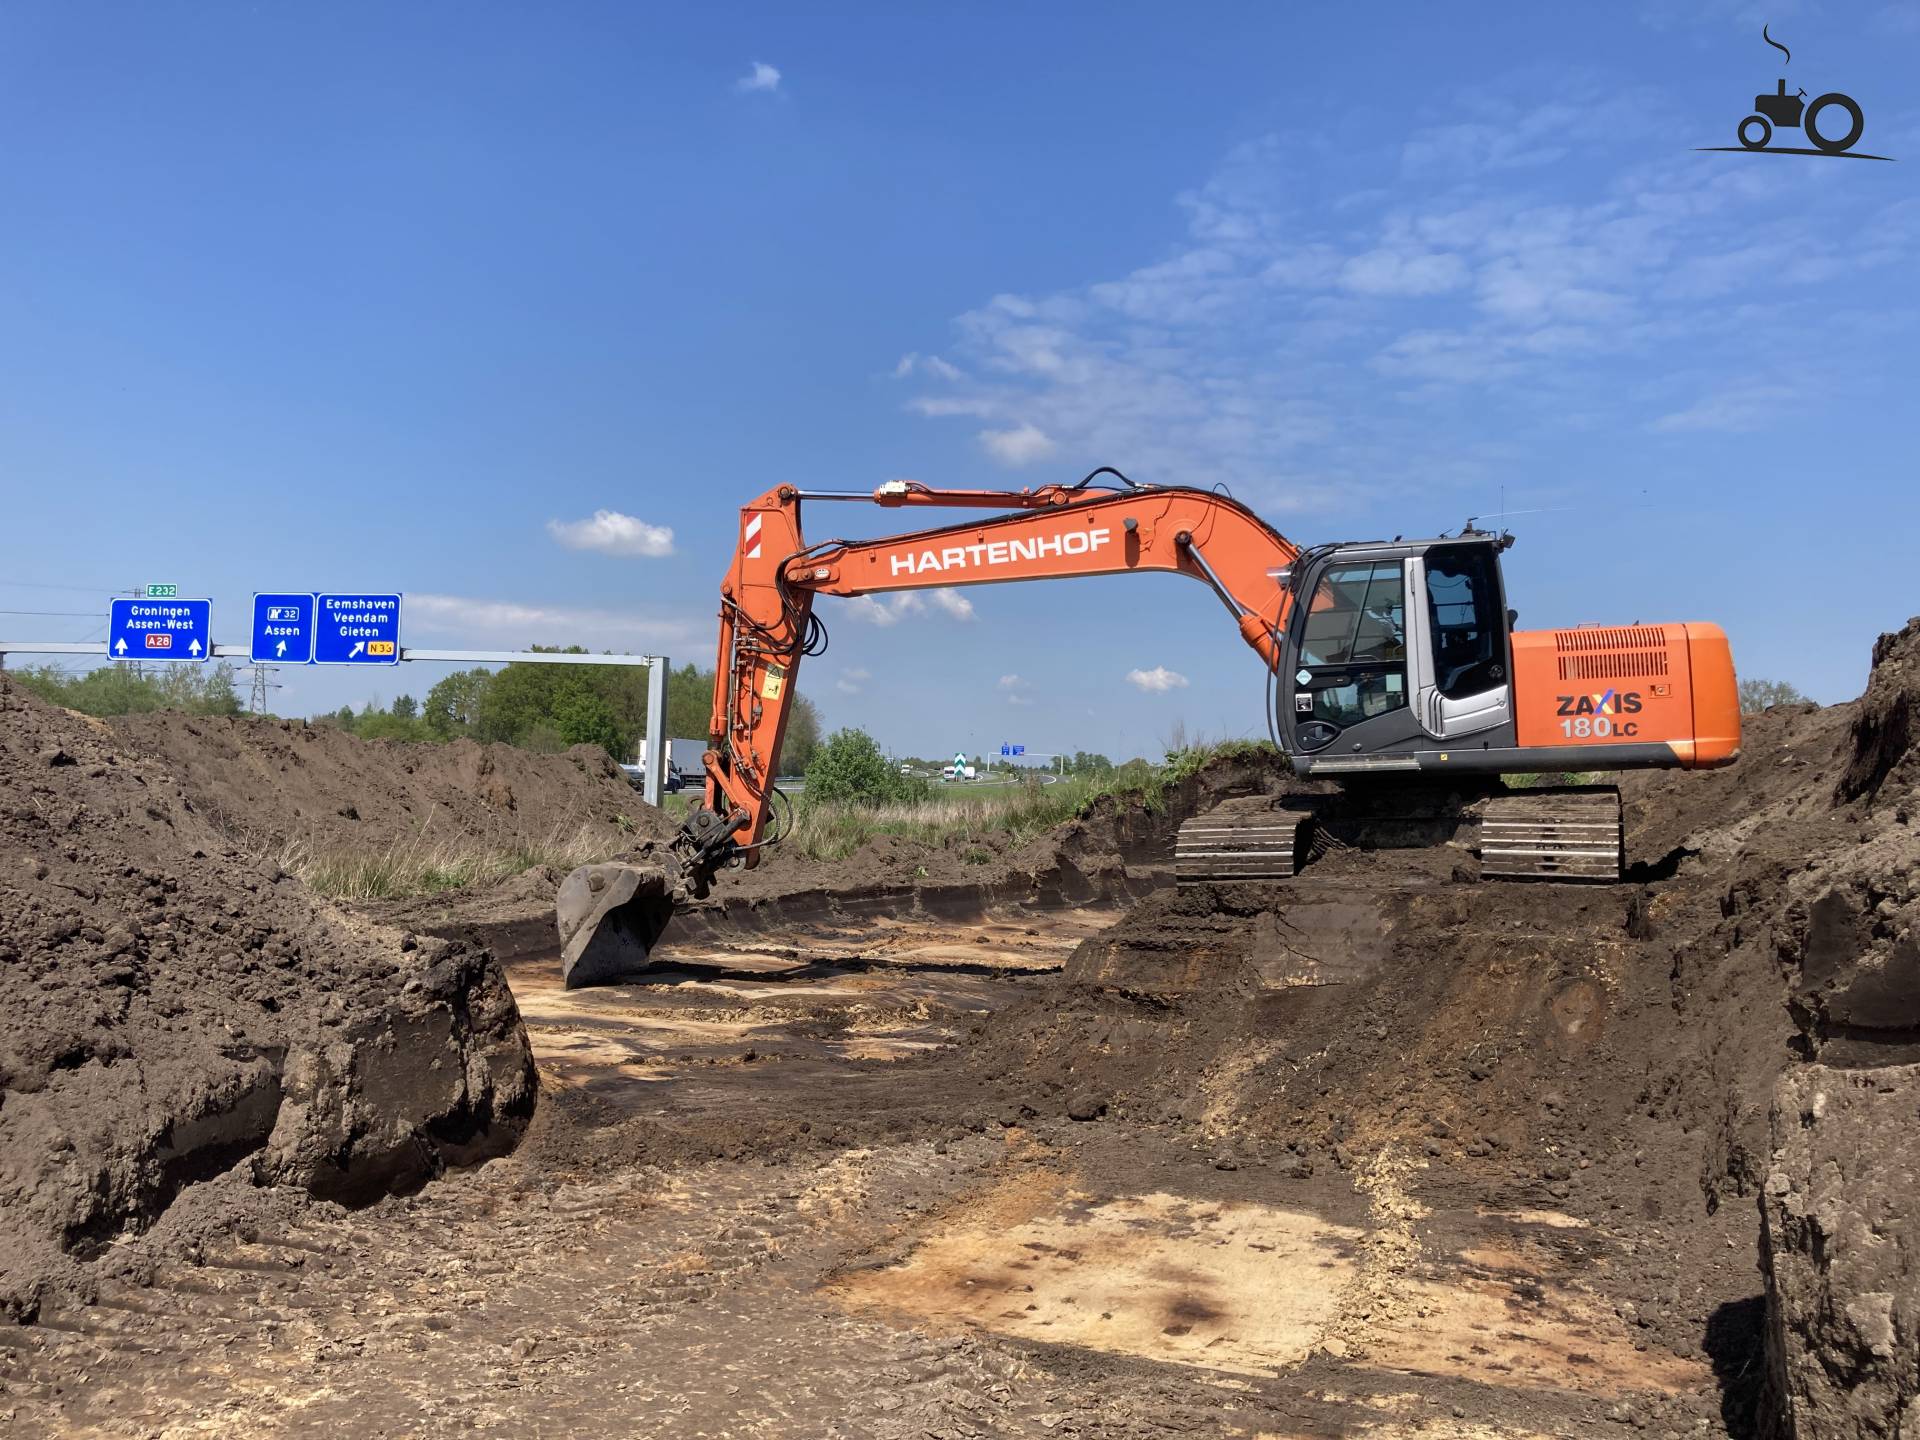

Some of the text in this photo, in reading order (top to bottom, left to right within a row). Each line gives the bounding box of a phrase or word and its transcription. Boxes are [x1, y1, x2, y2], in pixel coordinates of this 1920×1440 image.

[891, 529, 1110, 576] HARTENHOF
[326, 599, 395, 609] Eemshaven
[131, 605, 190, 618] Groningen
[283, 610, 296, 619] 32
[333, 612, 388, 623] Veendam
[126, 619, 194, 629] Assen-West
[264, 625, 300, 636] Assen
[339, 626, 379, 637] Gieten
[1556, 688, 1642, 716] ZAXIS
